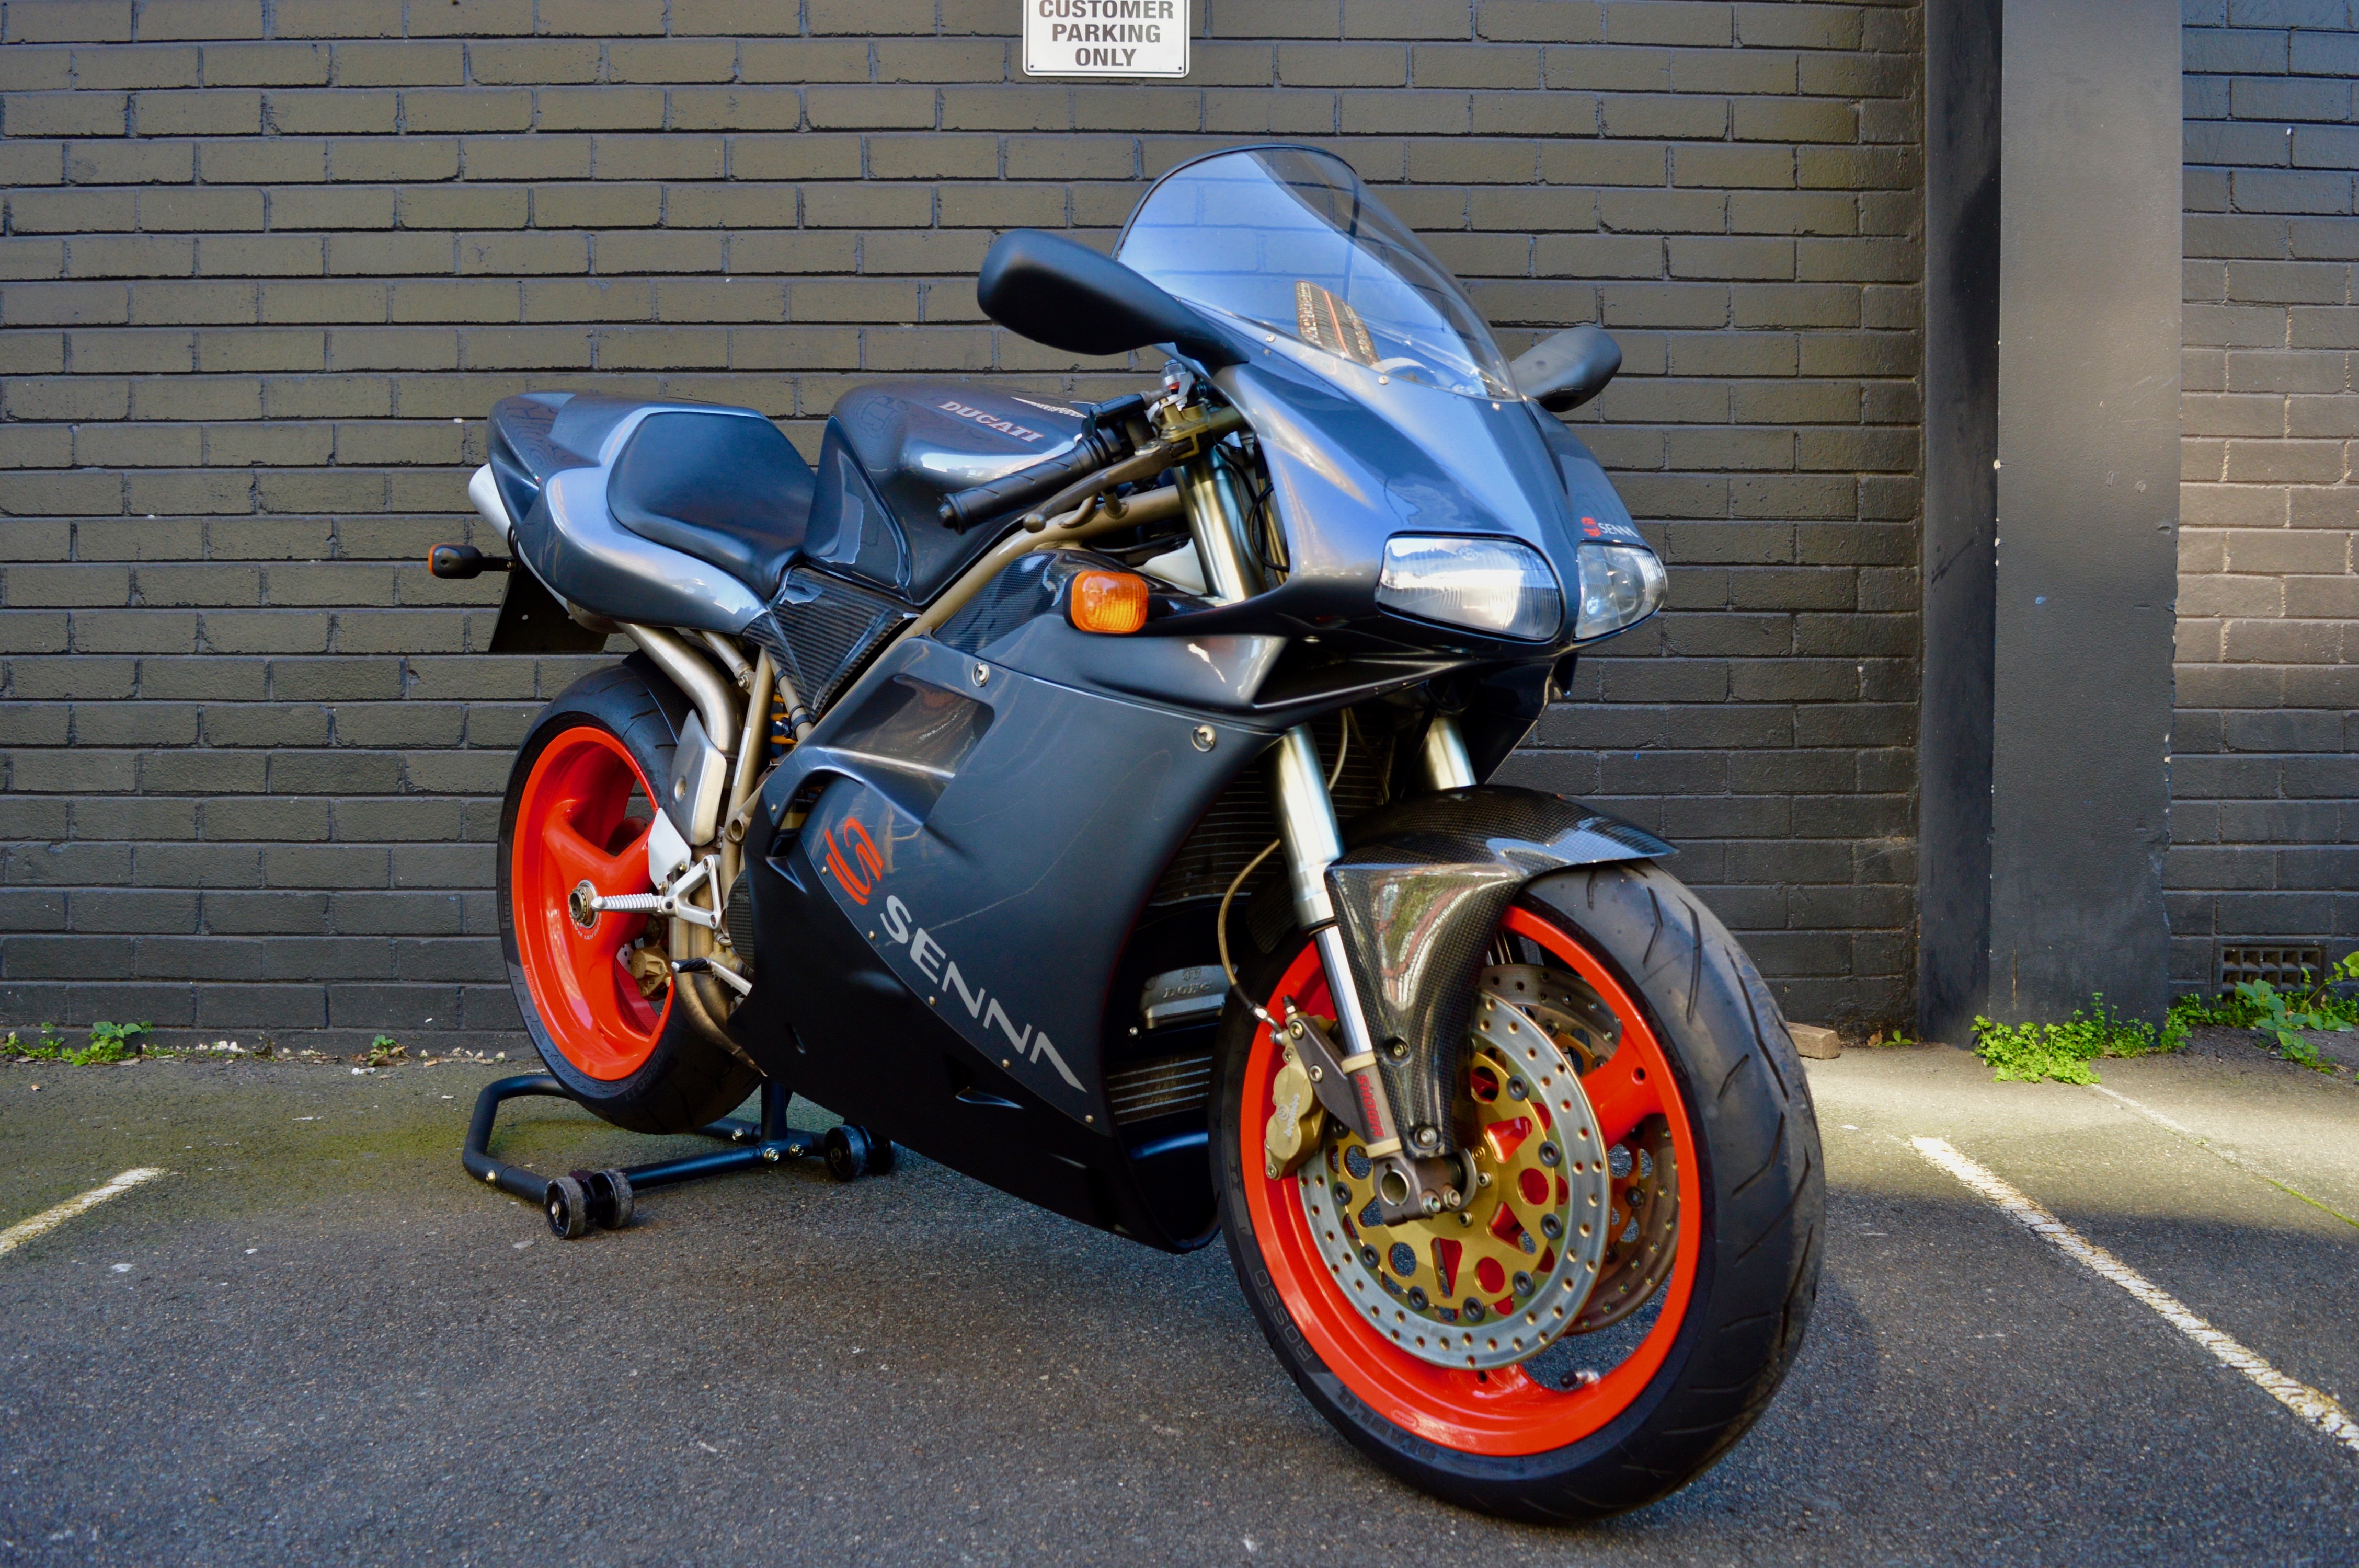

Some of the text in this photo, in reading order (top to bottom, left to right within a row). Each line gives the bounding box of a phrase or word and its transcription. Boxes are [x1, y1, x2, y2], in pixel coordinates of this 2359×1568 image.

[1039, 0, 1174, 19] CUSTOMER
[1052, 24, 1161, 43] PARKING
[1075, 48, 1137, 67] ONLY
[938, 401, 1045, 442] DUCATI
[1598, 523, 1639, 538] SENNA
[880, 895, 1088, 1093] SENNA
[1283, 1093, 1300, 1137] brembo
[1356, 1074, 1385, 1138] SHOWA
[1255, 1269, 1313, 1362] ROSSO
